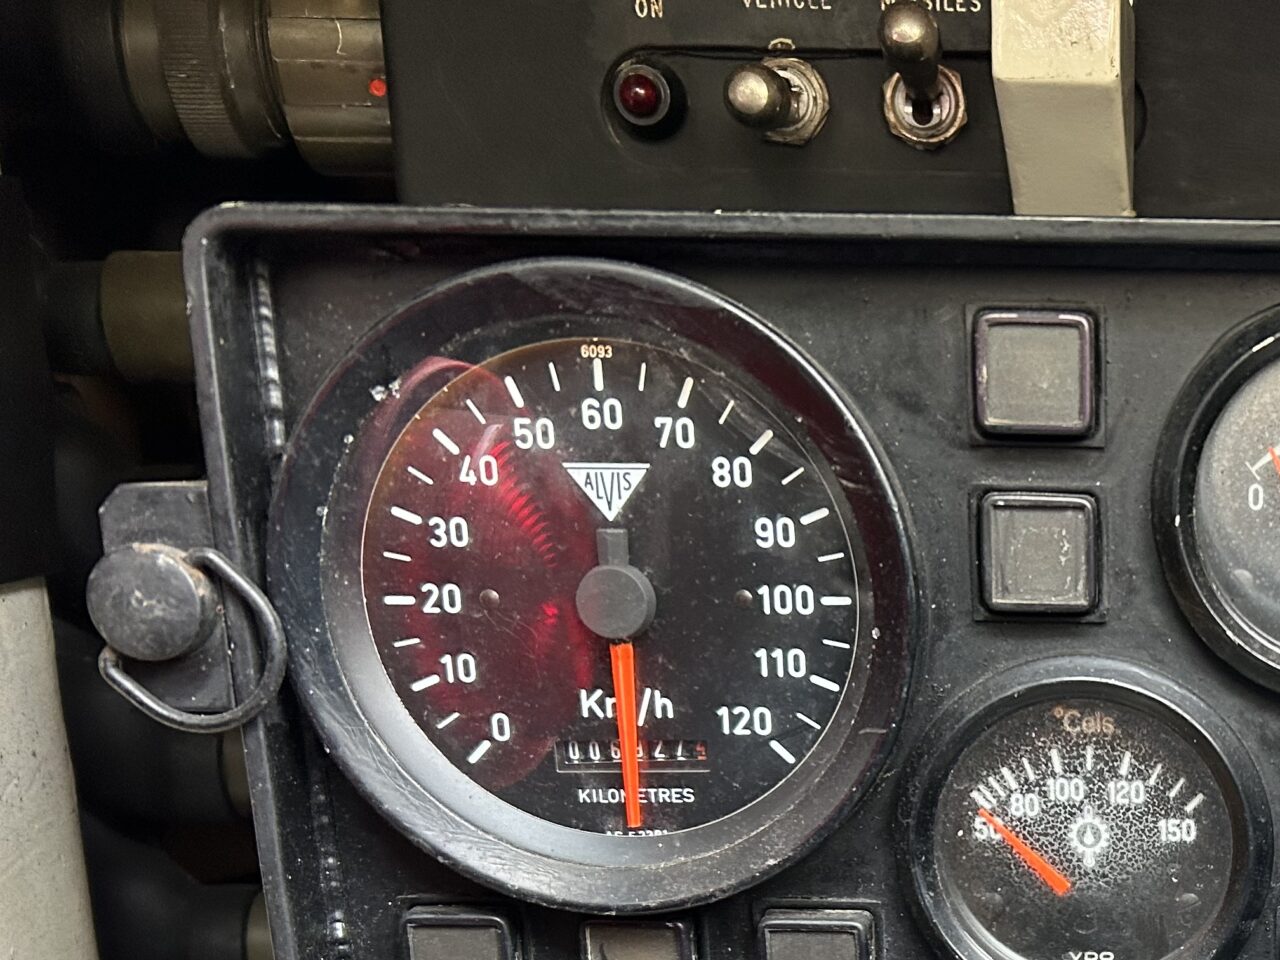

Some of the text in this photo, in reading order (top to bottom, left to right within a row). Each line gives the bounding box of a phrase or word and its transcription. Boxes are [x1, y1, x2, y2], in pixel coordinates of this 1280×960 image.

[635, 0, 663, 18] ON
[580, 345, 613, 359] 6093
[581, 397, 623, 430] 60
[513, 417, 556, 450] 50
[654, 416, 696, 449] 70
[459, 454, 499, 487] 40
[711, 456, 753, 488] 80
[584, 471, 632, 511] ALVIS
[1247, 483, 1264, 511] 0
[428, 516, 470, 548] 30
[754, 517, 797, 548] 90
[421, 583, 462, 615] 20
[757, 584, 815, 615] 100
[439, 653, 477, 684] 10
[755, 648, 807, 679] 110
[491, 712, 511, 741] 0
[717, 705, 773, 737] 120
[578, 787, 696, 804] KILOETRES
[1009, 792, 1040, 817] 80
[1048, 777, 1085, 802] 100
[1108, 780, 1145, 804] 120
[1158, 818, 1197, 843] 150
